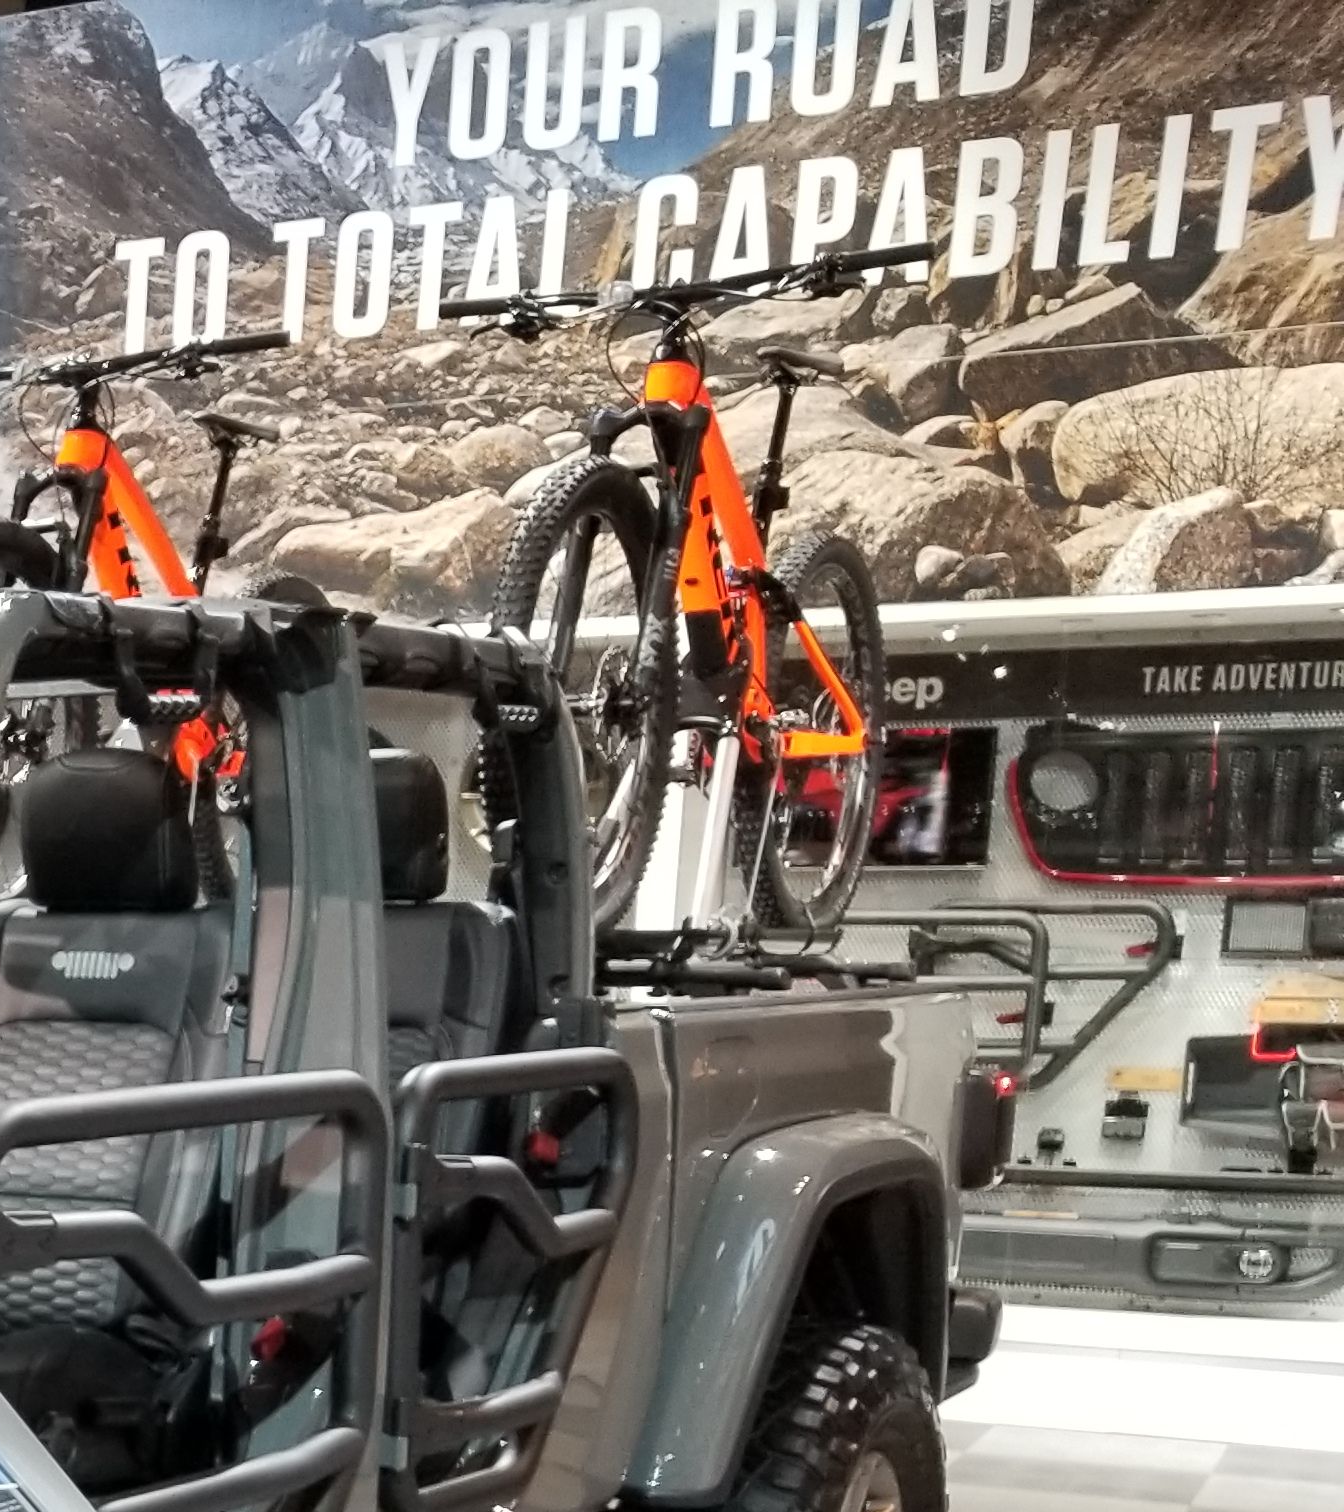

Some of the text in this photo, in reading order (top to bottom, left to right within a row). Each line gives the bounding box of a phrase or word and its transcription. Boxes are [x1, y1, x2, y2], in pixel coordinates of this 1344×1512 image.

[383, 5, 662, 167] YOUR
[114, 229, 230, 355] TO
[272, 188, 582, 339] TOTAL
[883, 676, 944, 710] ep
[1142, 659, 1344, 693] TAKE ADVENTUR
